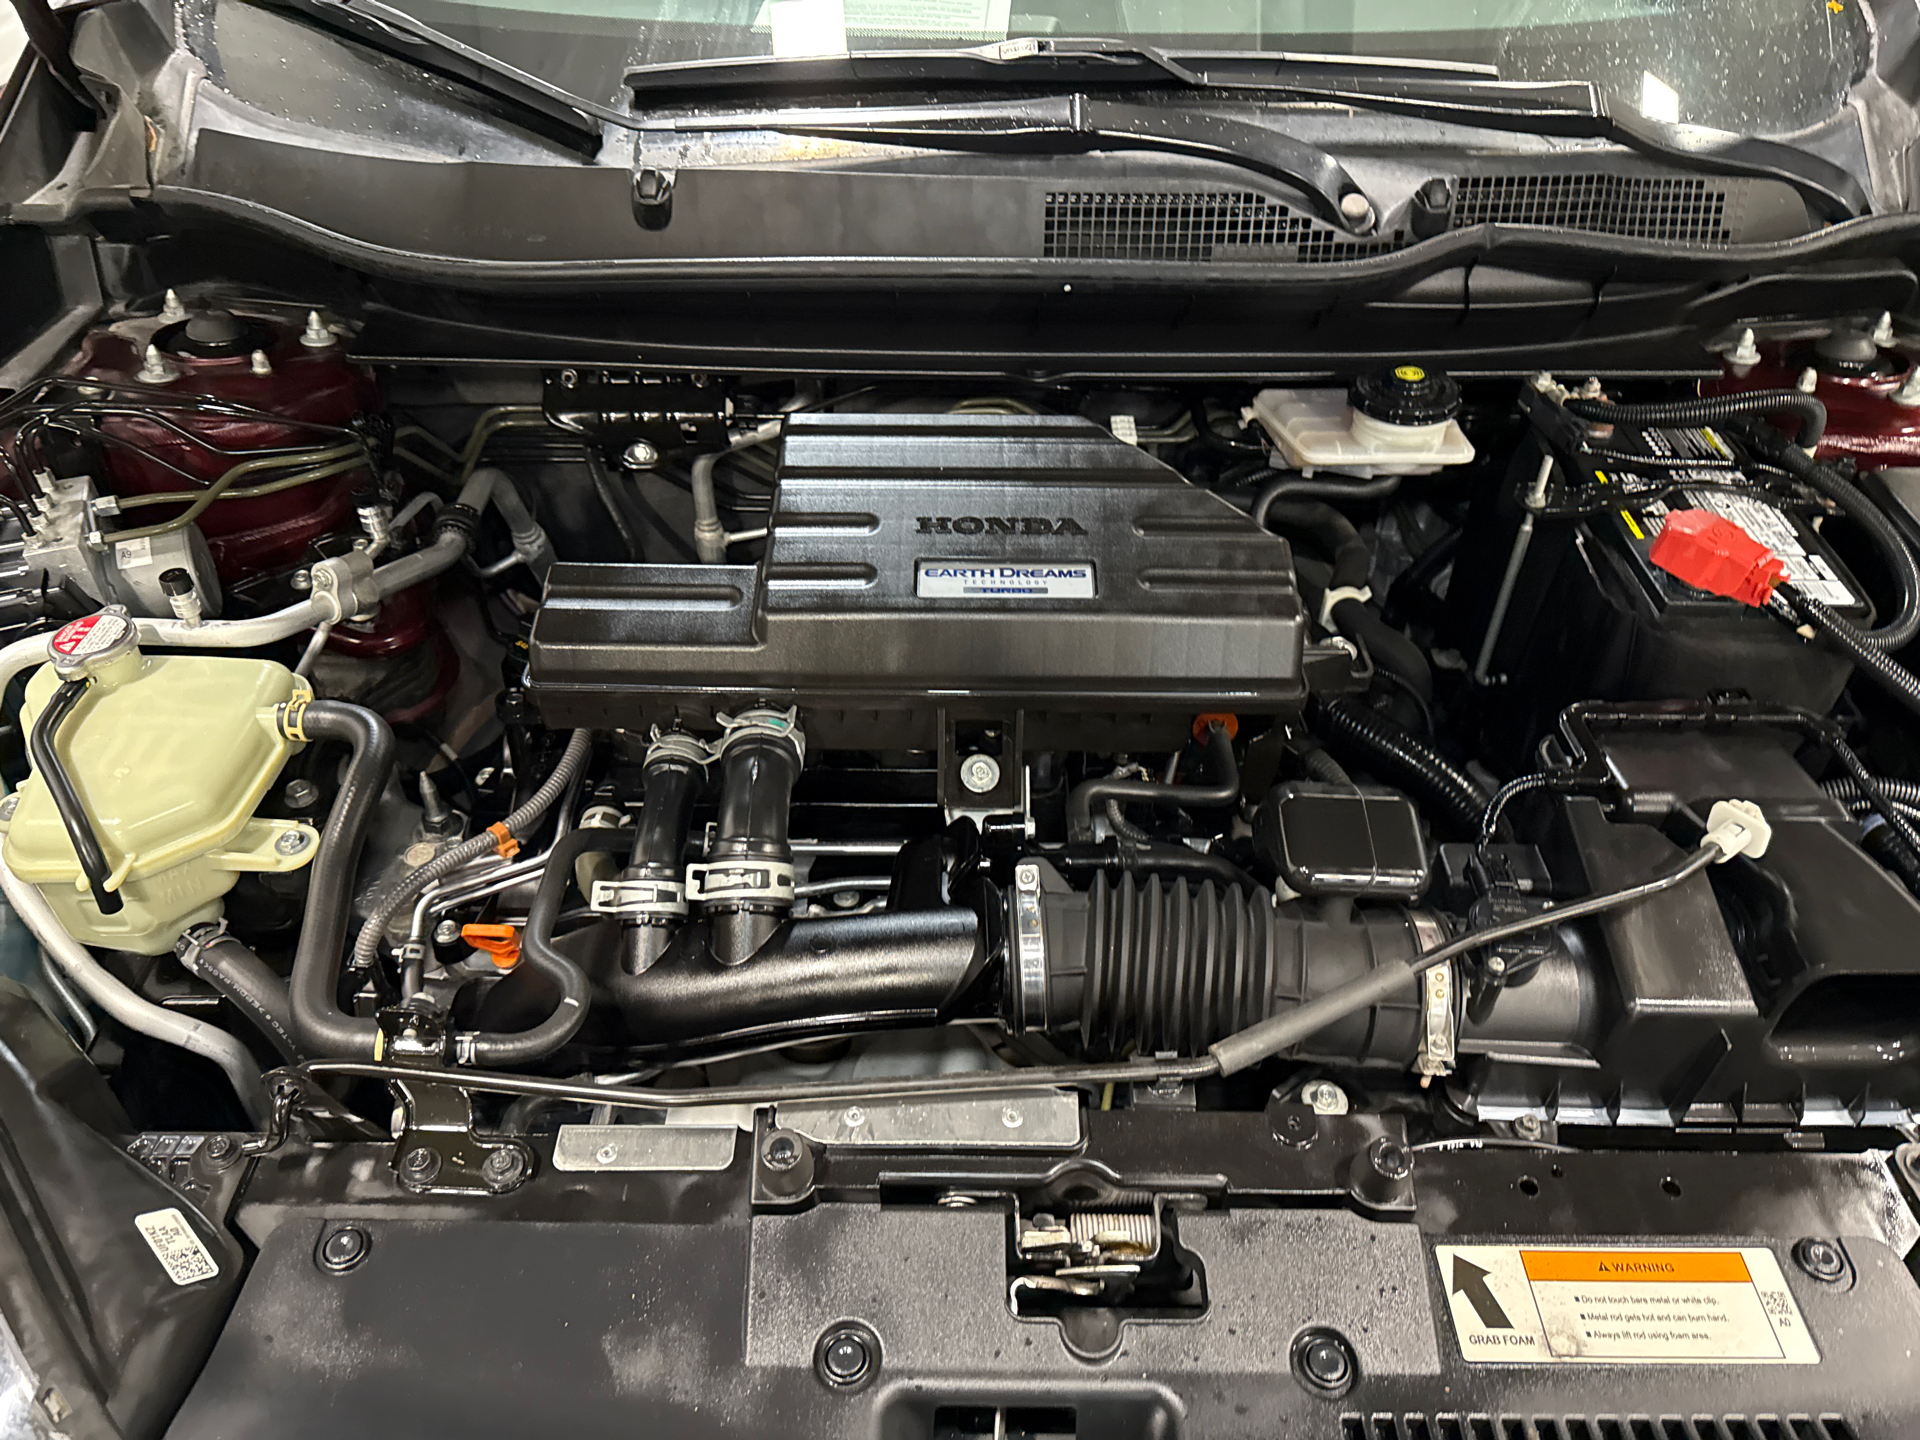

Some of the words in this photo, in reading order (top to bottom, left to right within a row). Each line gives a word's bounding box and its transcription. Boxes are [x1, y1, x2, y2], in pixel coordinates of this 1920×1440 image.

[916, 517, 1088, 535] HONDA
[121, 550, 132, 560] A9
[925, 569, 995, 578] EARTH
[1000, 567, 1086, 578] DREAMS
[1612, 1261, 1675, 1274] WARNING
[1581, 1296, 1592, 1304] Do
[1594, 1295, 1606, 1304] not
[1608, 1295, 1629, 1304] touch
[1630, 1295, 1648, 1305] bare
[1650, 1296, 1670, 1305] metal
[1672, 1297, 1680, 1305] or
[1681, 1296, 1702, 1305] white
[1587, 1313, 1608, 1321] Metal
[1625, 1314, 1640, 1323] gets
[1657, 1314, 1671, 1322] and
[1688, 1314, 1706, 1322] burn
[1469, 1334, 1501, 1346] GRAB
[1503, 1335, 1535, 1347] FOAM
[1594, 1331, 1620, 1341] Always
[1622, 1331, 1632, 1339] lift
[1633, 1331, 1646, 1340] rod
[1648, 1332, 1669, 1341] using
[1670, 1331, 1689, 1340] foam
